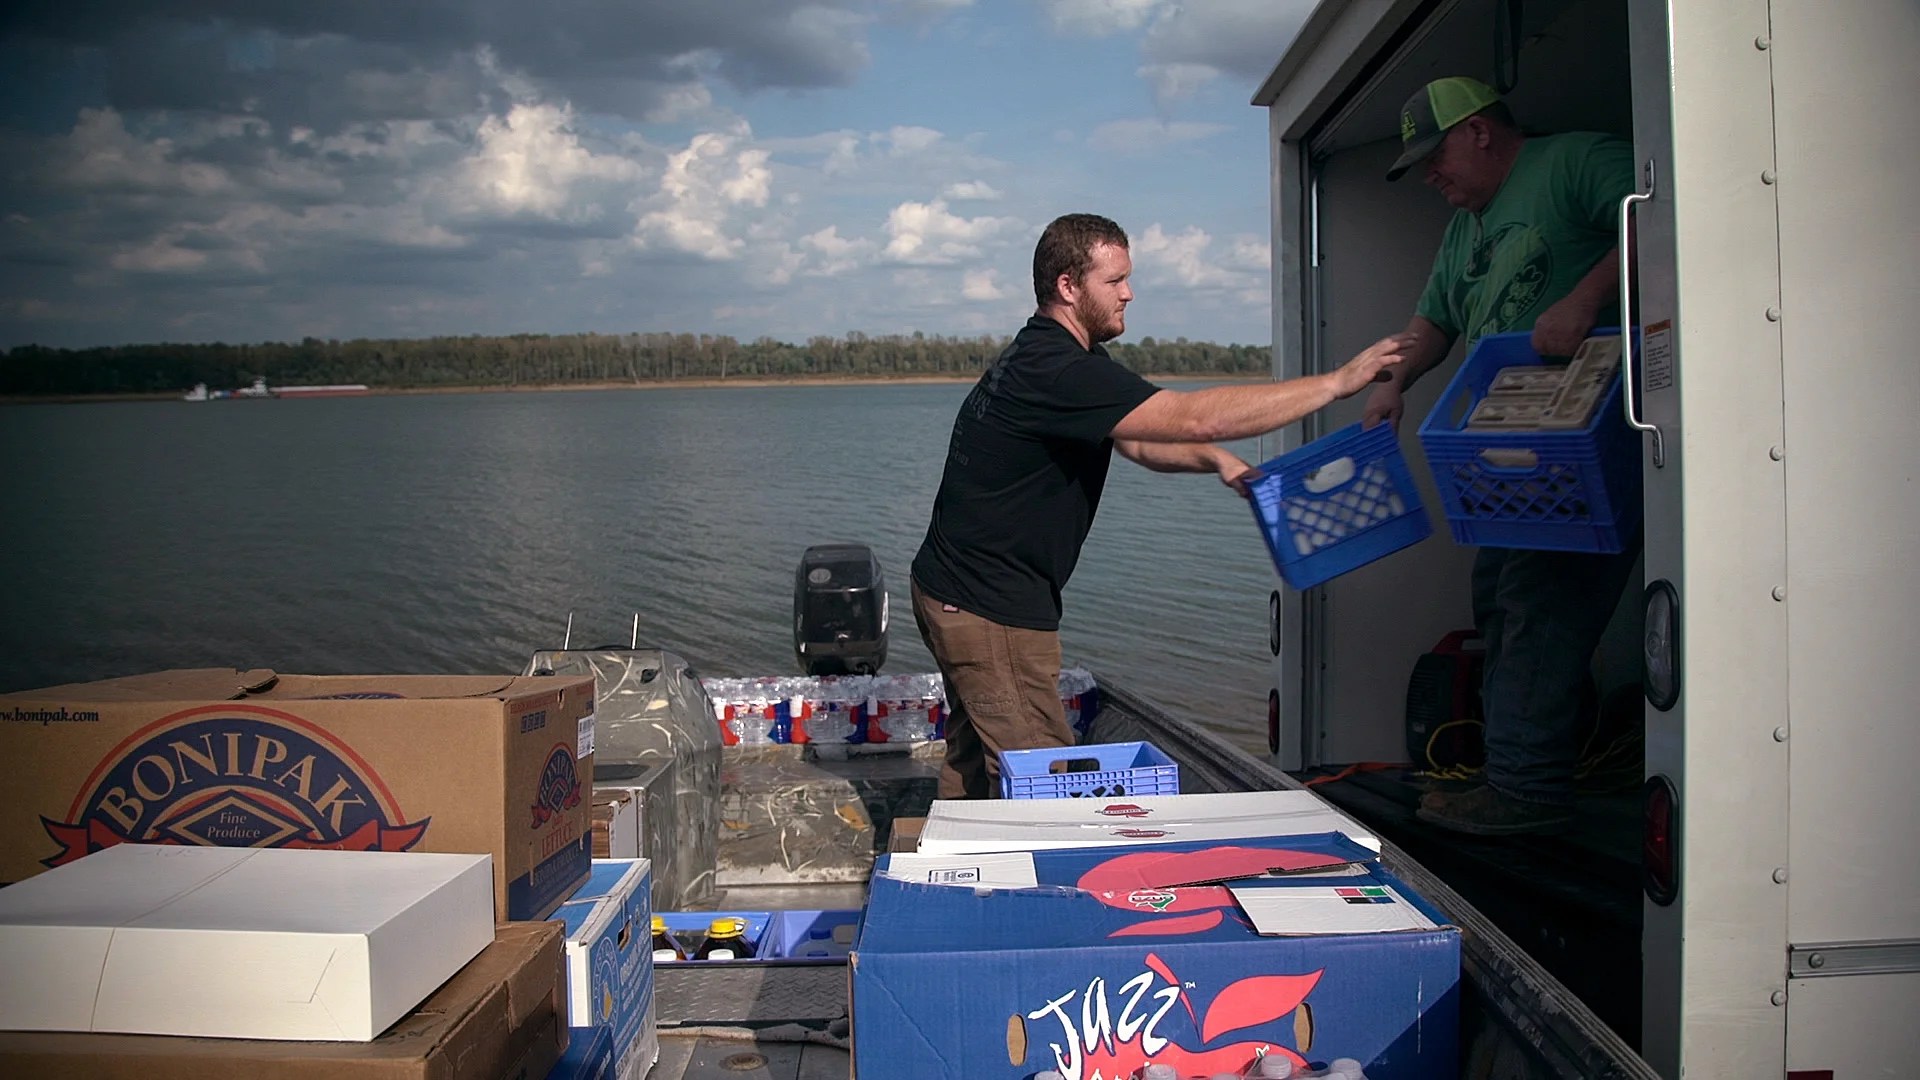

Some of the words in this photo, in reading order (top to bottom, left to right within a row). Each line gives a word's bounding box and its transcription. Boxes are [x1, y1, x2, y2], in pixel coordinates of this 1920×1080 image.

[96, 732, 366, 836] BONIPAK
[219, 811, 248, 825] Fine
[207, 825, 261, 839] Produce
[541, 820, 574, 859] LETTUCE
